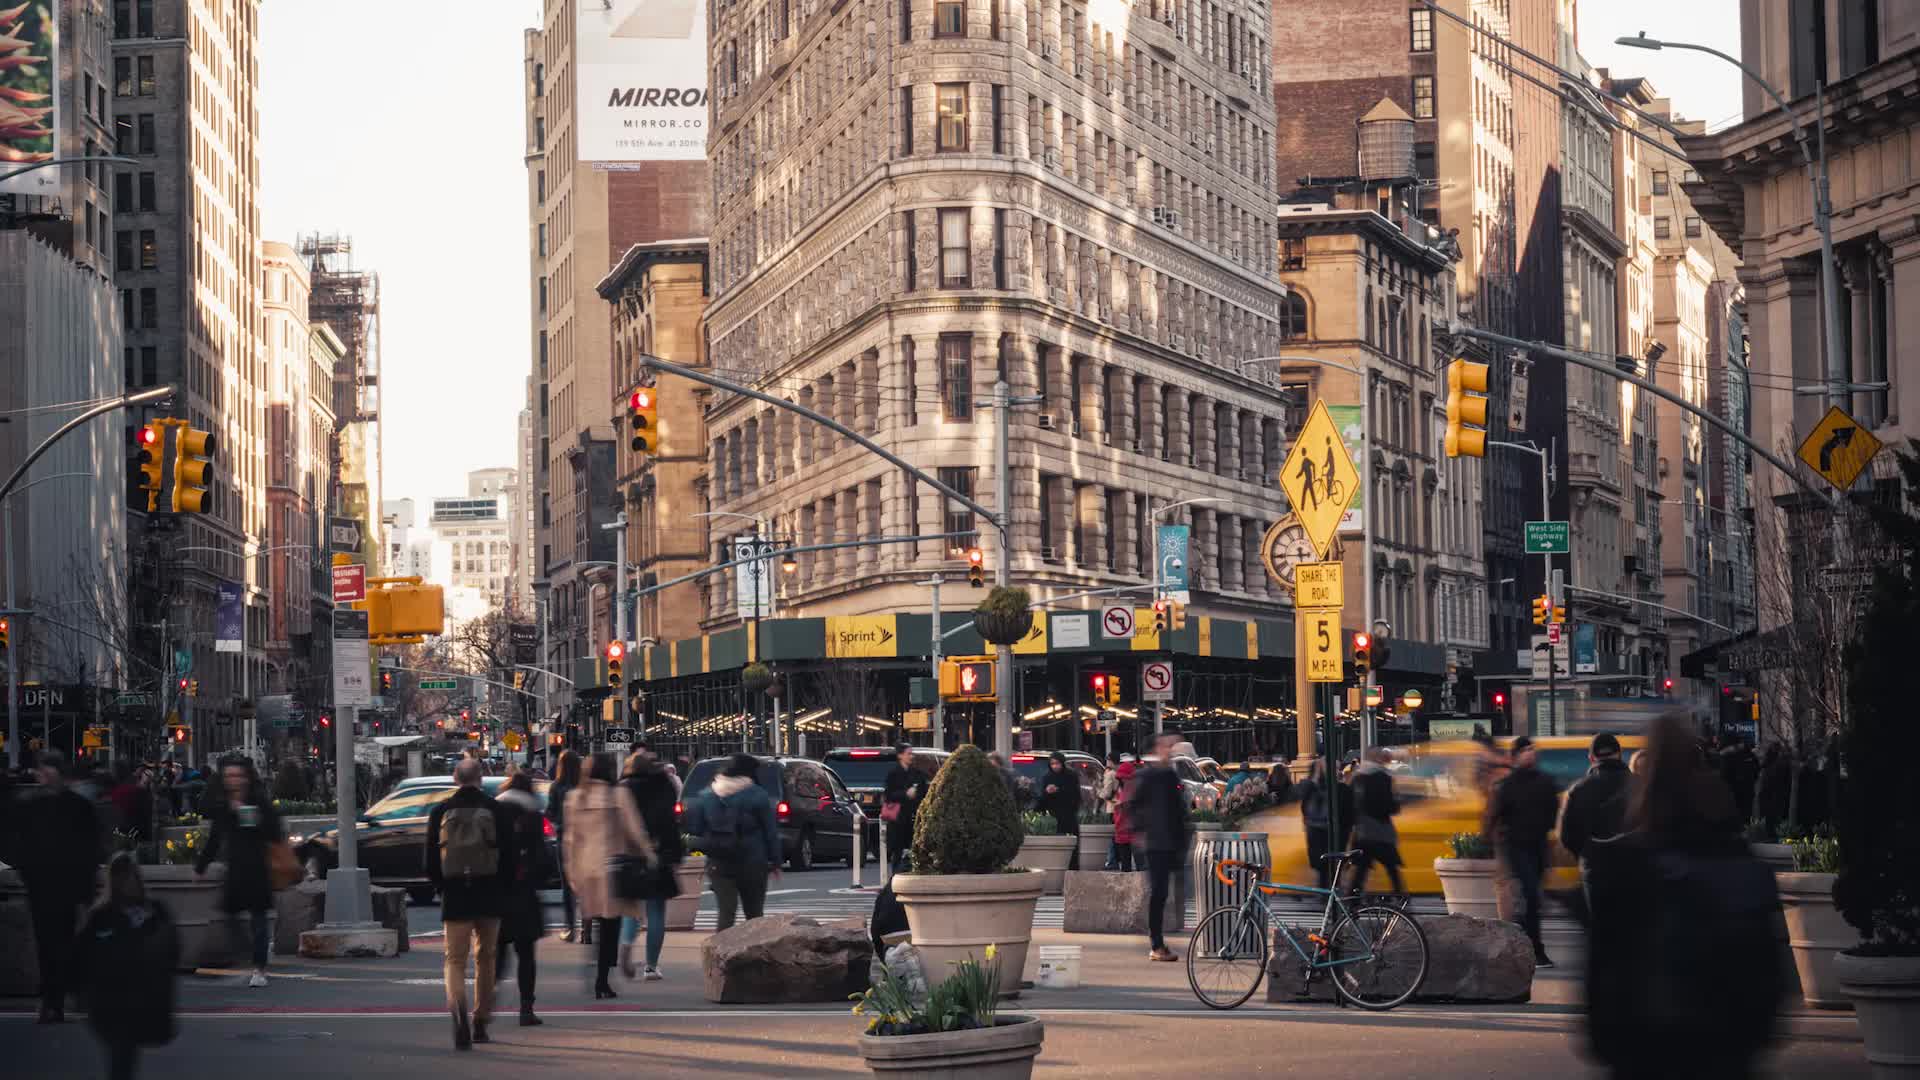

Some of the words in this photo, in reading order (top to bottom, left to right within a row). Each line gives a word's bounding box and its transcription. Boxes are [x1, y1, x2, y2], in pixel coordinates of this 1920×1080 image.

[1550, 524, 1566, 532] Side
[1531, 533, 1564, 541] Highway
[1301, 569, 1324, 584] SHARE
[1326, 568, 1337, 582] THE
[1311, 587, 1329, 601] ROAD
[840, 631, 875, 645] Sprint
[1317, 620, 1330, 653] 5
